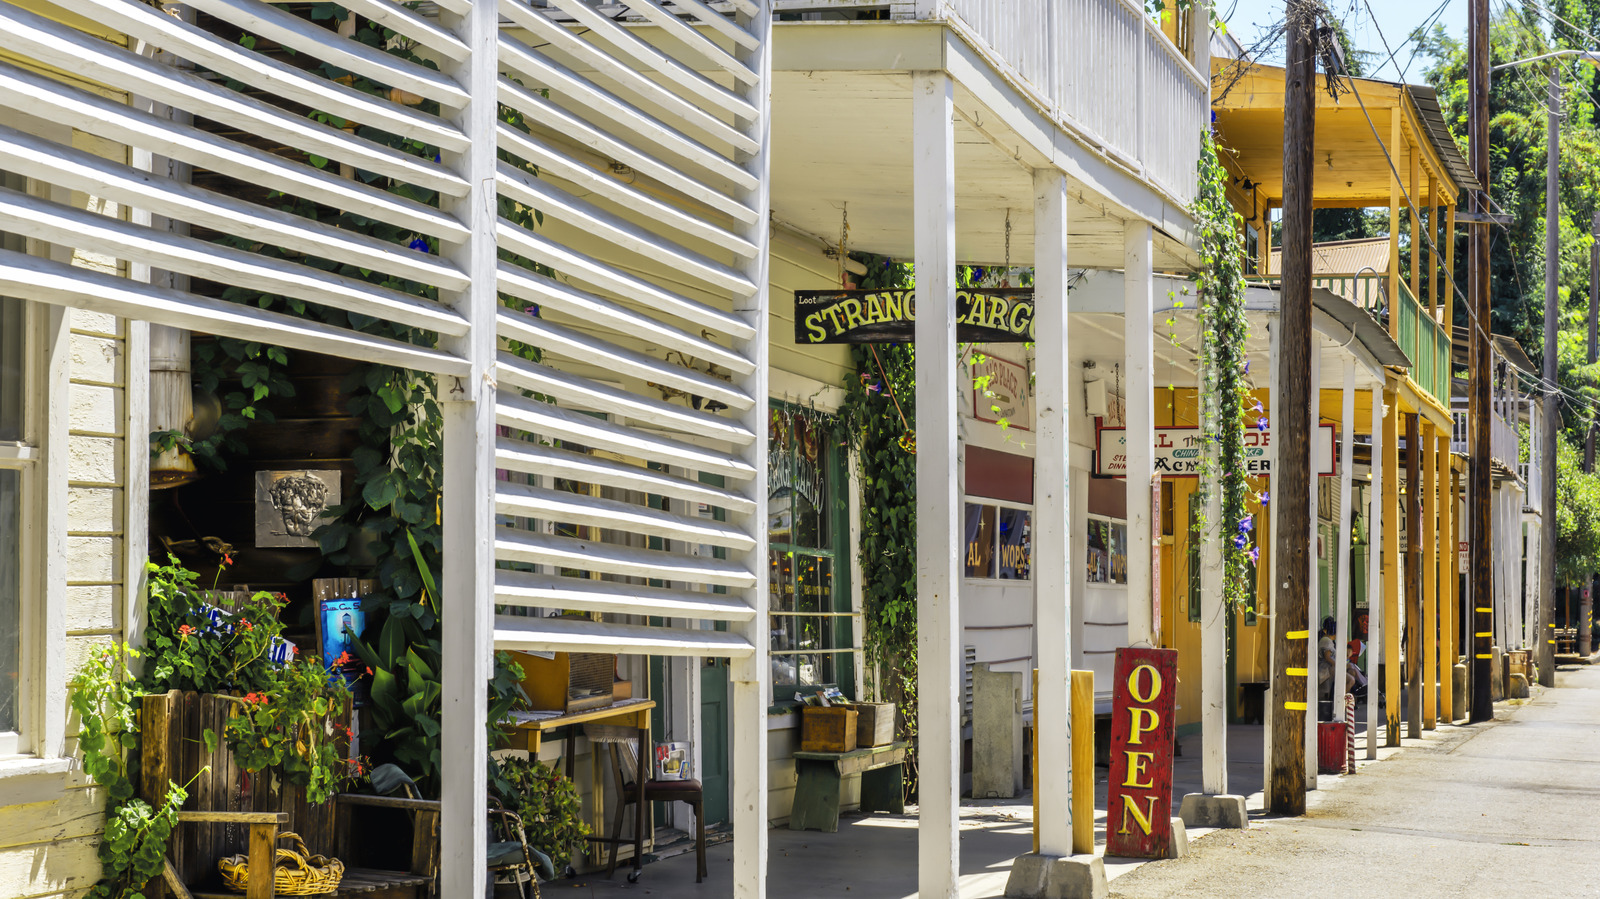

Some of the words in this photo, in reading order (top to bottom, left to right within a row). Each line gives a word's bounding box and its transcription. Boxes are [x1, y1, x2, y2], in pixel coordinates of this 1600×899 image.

[798, 295, 817, 305] Loot
[805, 290, 916, 343] STRANG
[999, 362, 1018, 399] PLACE
[967, 541, 982, 567] AL
[1001, 543, 1025, 568] WOPS
[1459, 543, 1468, 551] NO
[1089, 552, 1097, 573] AL
[1117, 664, 1162, 836] OPEN
